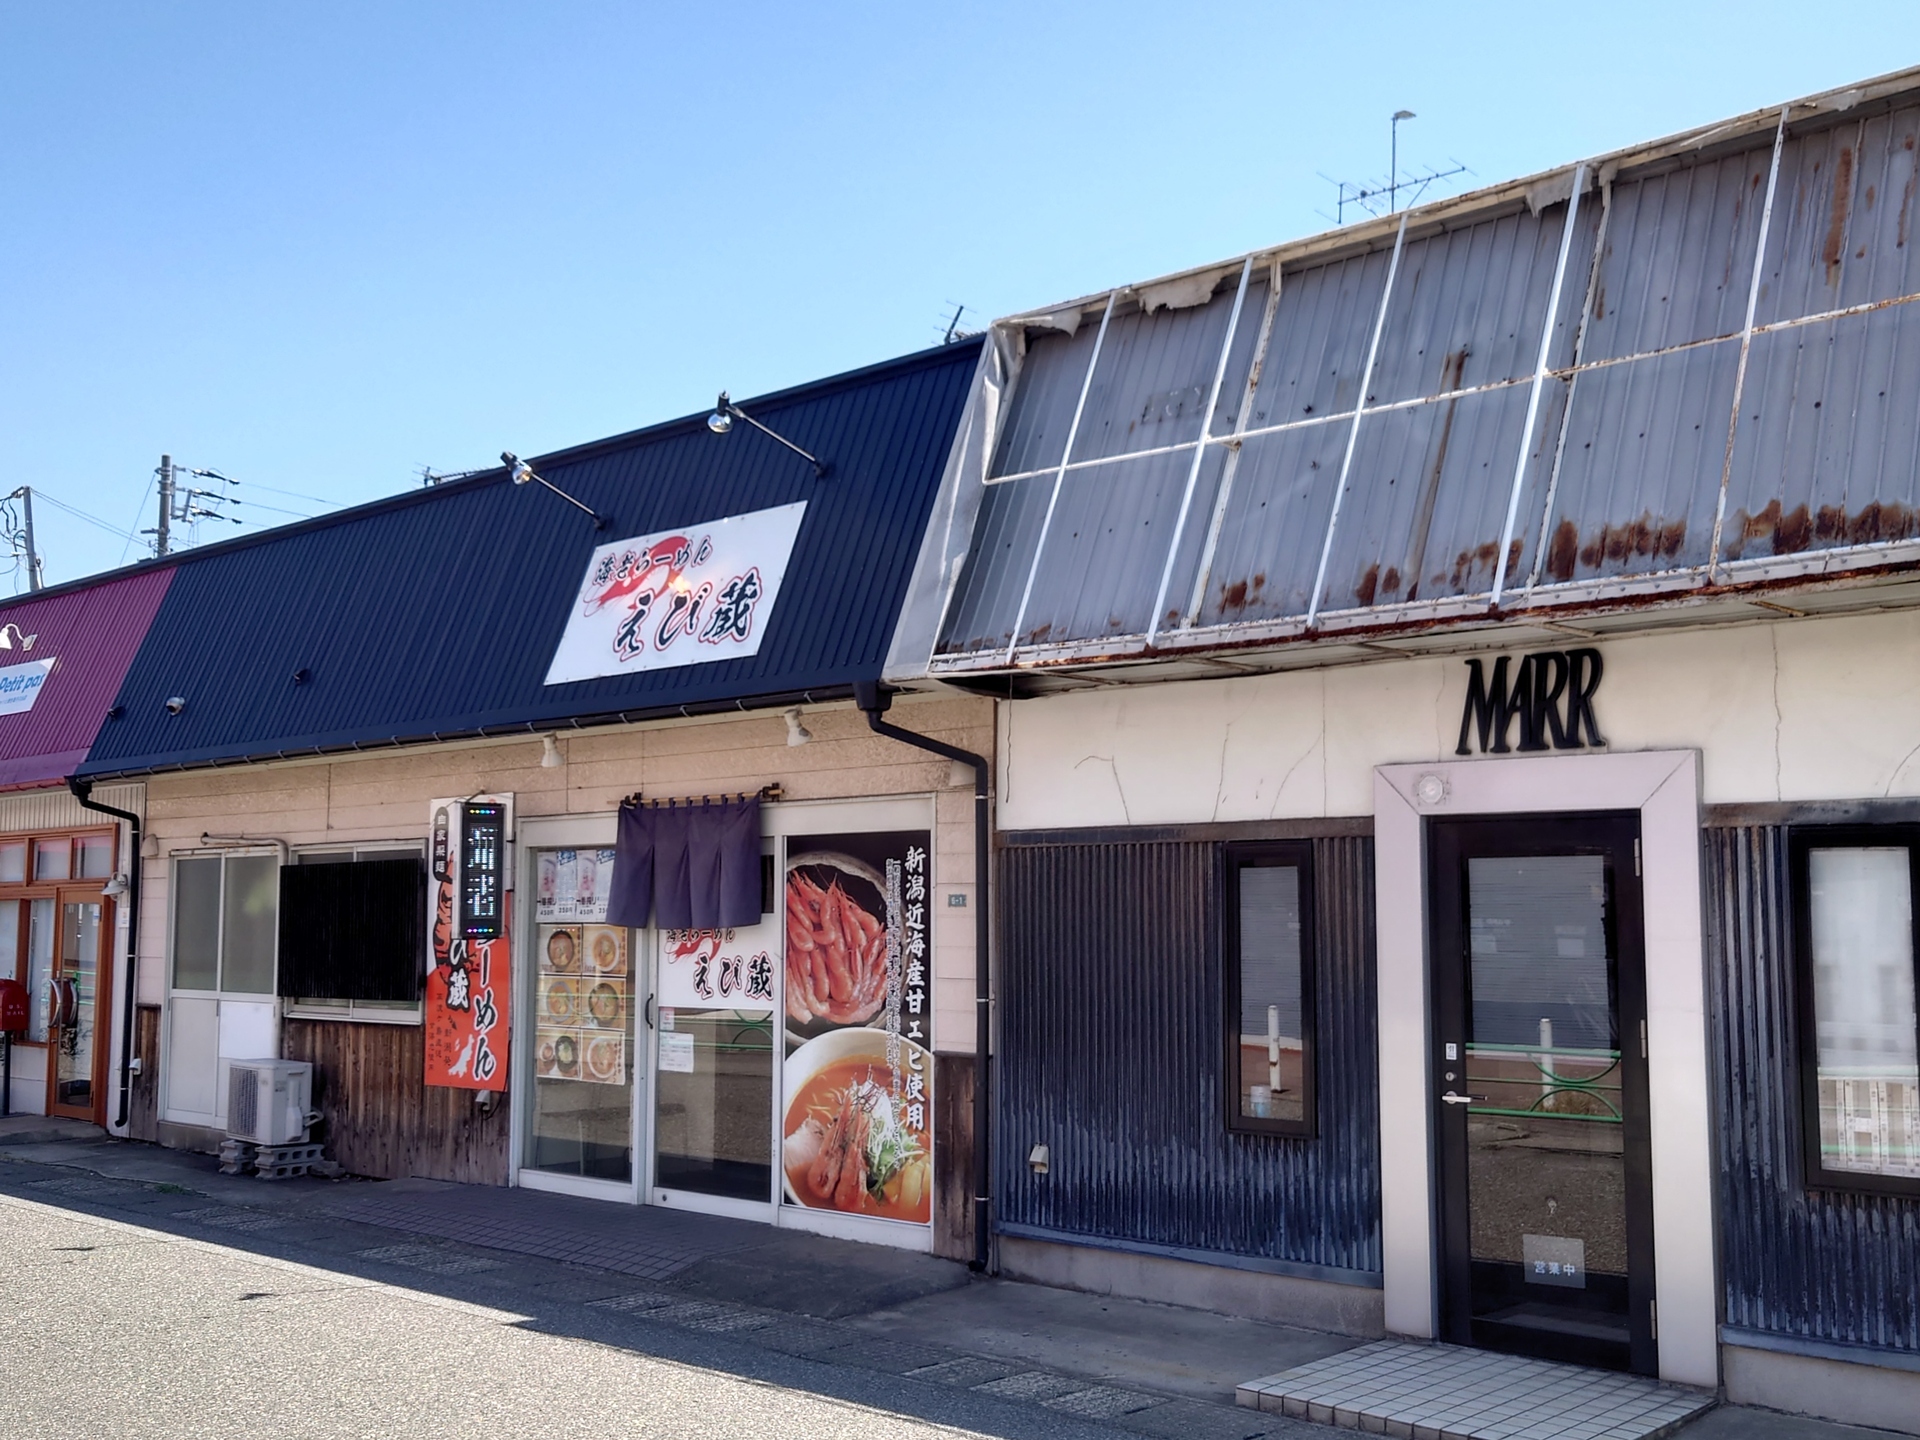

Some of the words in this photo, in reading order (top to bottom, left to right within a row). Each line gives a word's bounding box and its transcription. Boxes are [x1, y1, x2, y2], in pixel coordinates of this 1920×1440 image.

[614, 568, 761, 660] えび蔵
[1455, 648, 1606, 755] MARR
[474, 939, 497, 1081] ーめん
[694, 953, 773, 999] えび蔵
[904, 845, 926, 1131] 新潟近海産甘エビ使用
[1534, 1260, 1576, 1277] 営業中
